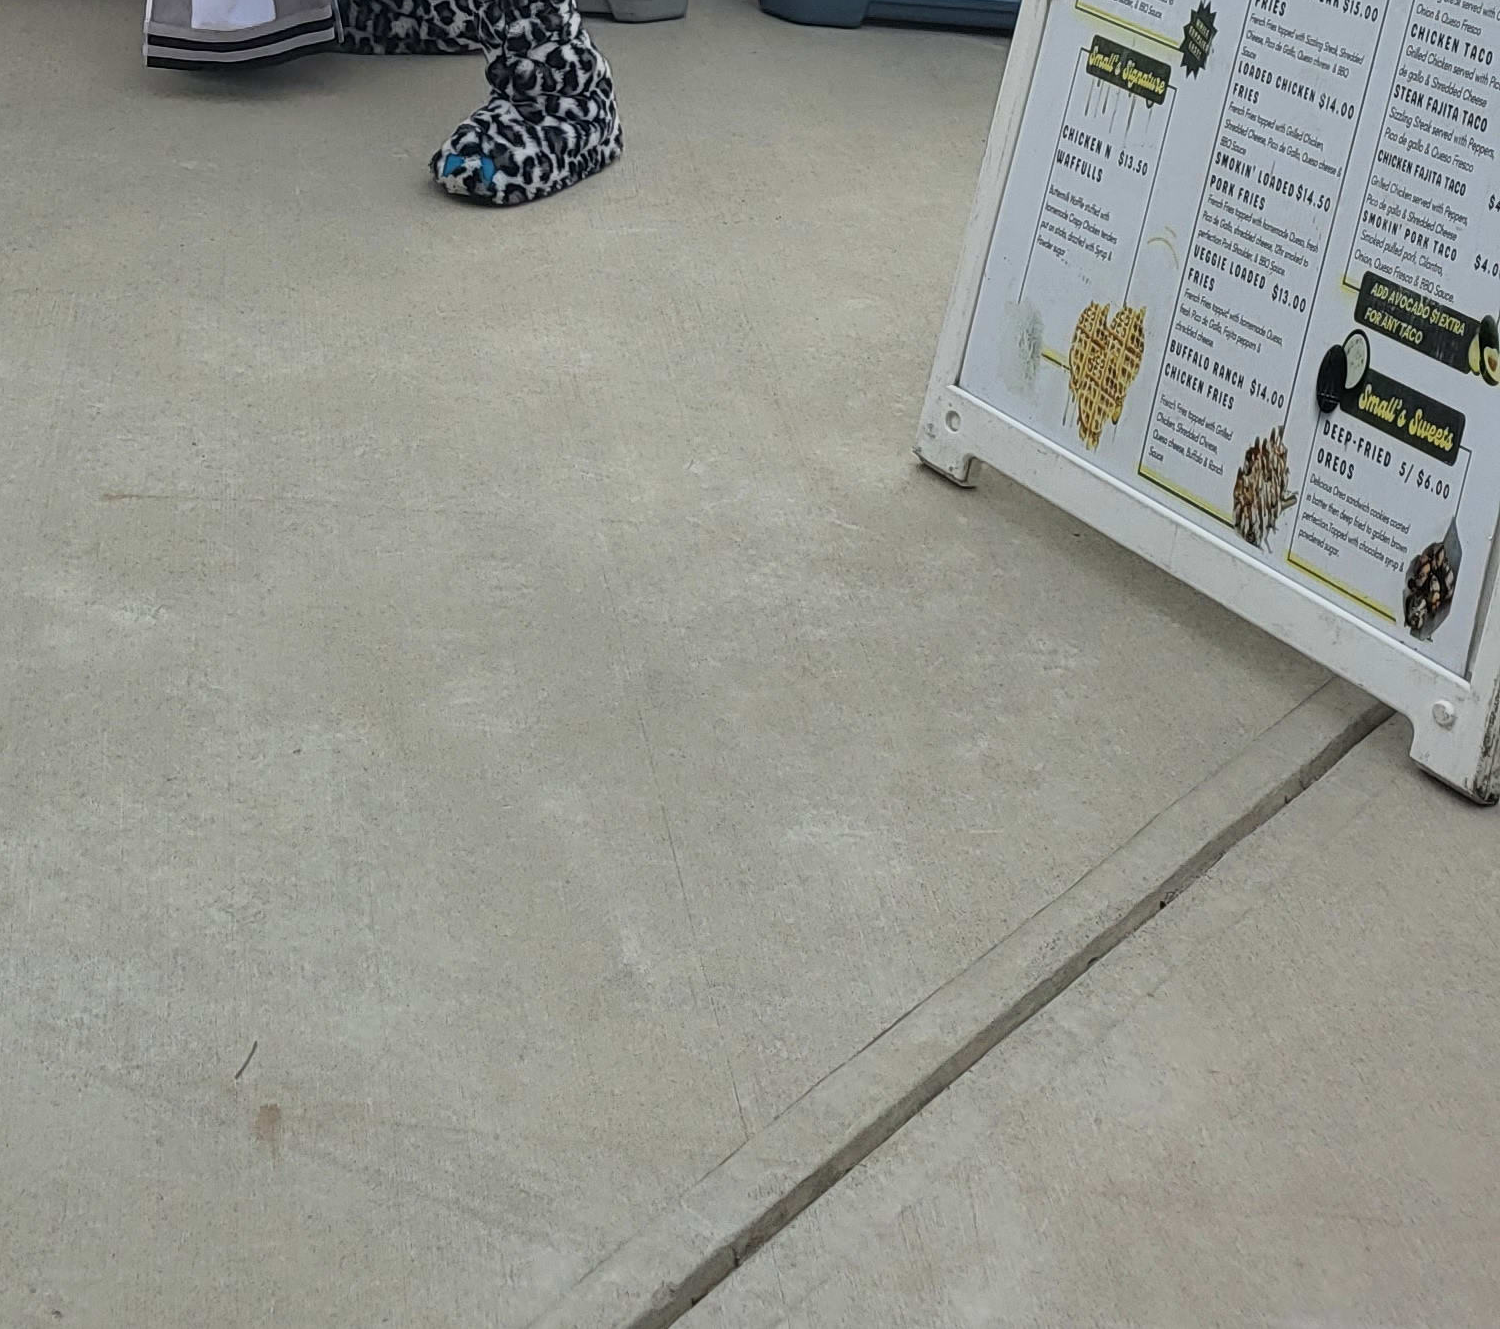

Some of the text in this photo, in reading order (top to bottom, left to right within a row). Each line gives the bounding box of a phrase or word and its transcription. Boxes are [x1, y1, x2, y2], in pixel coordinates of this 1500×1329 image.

[1410, 23, 1493, 65] CHICKEN TACO
[1088, 45, 1165, 94] Small's Signature
[1233, 83, 1260, 104] FRIES
[1238, 60, 1355, 119] LOADED CHICKEN $14.00
[1453, 64, 1476, 80] served
[1475, 73, 1489, 85] with
[1393, 84, 1488, 133] STEAK FAJITA TACO
[1413, 116, 1432, 132] Steak
[1432, 125, 1454, 141] served
[1454, 133, 1467, 146] with
[1056, 148, 1103, 183] WAFFULLS
[1062, 124, 1148, 176] CHICKEN N $13.50
[1377, 149, 1412, 174] CHICKEN
[1414, 162, 1442, 187] FAJITA
[1444, 176, 1467, 196] TACO
[1210, 175, 1266, 211] PORK FRIES
[1215, 151, 1331, 212] SMOKIN' LOADED $14.50
[1362, 209, 1500, 277] SMOKIN' PORK TACO $4.0
[1187, 267, 1215, 291] FRIES
[1193, 244, 1306, 313] VEGGIE LOADED $13.00
[1364, 307, 1424, 345] FOR ANY TACO
[1370, 283, 1466, 336] ADD AVOCADO $1 EXTRA
[1164, 363, 1235, 410] CHICKEN FRIES
[1169, 339, 1284, 409] BUFFALO RANCH $14.00
[1358, 383, 1454, 452] Small's Sweets
[1317, 448, 1355, 480] OREOS
[1323, 419, 1450, 500] DEEP-FRIED 5/ $6.00
